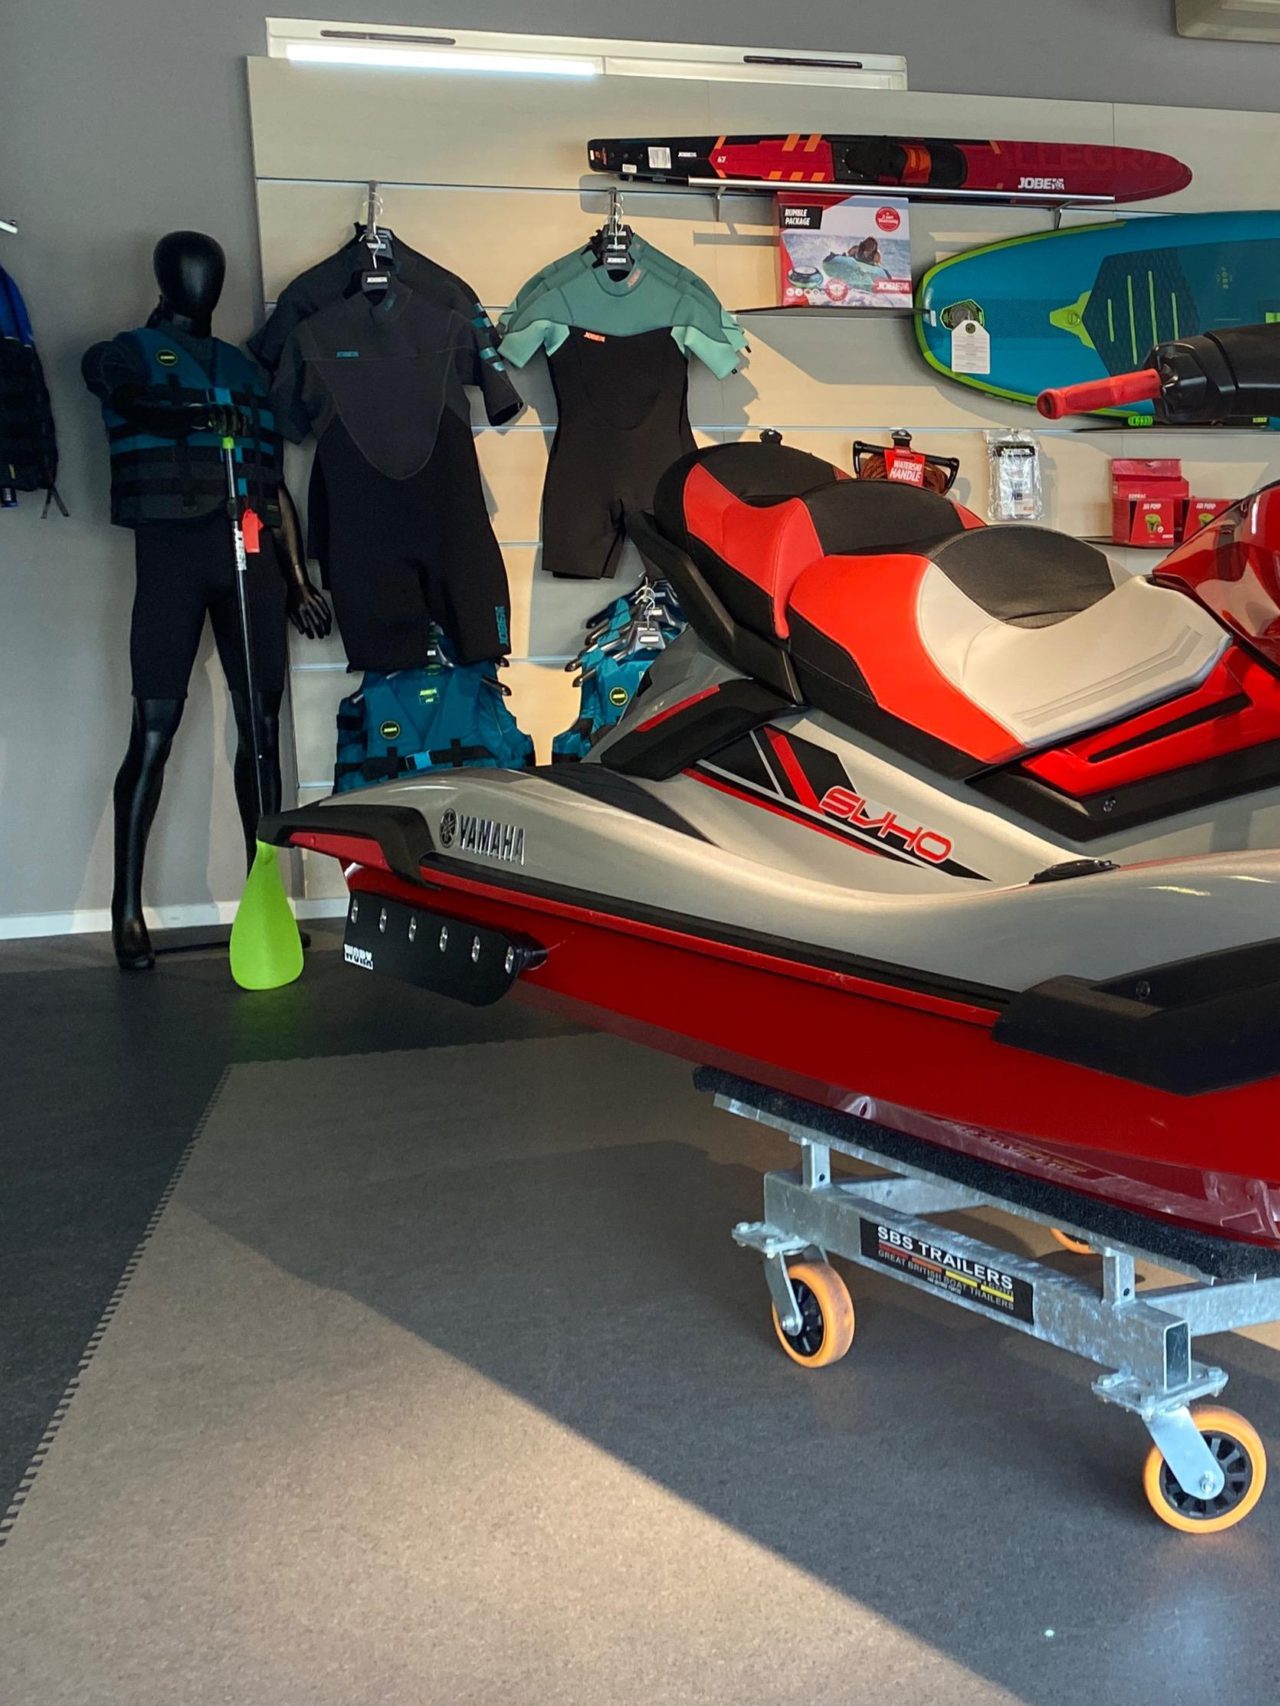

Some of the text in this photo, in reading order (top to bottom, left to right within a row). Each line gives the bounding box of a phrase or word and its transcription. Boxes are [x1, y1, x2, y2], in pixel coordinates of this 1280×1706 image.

[1018, 177, 1053, 190] JOBE
[785, 208, 808, 217] RUMBLE
[785, 217, 811, 226] PACKAGE
[893, 460, 923, 470] WATERSKI
[889, 468, 922, 483] HANDLE
[460, 814, 526, 866] YAMAHA
[877, 1226, 913, 1250] SBS
[918, 1241, 1013, 1290] TRAILERS
[878, 1250, 907, 1267] GREAT
[907, 1261, 942, 1282] BRITISH
[943, 1272, 967, 1291] BOAT
[969, 1286, 1014, 1311] TRAILERS
